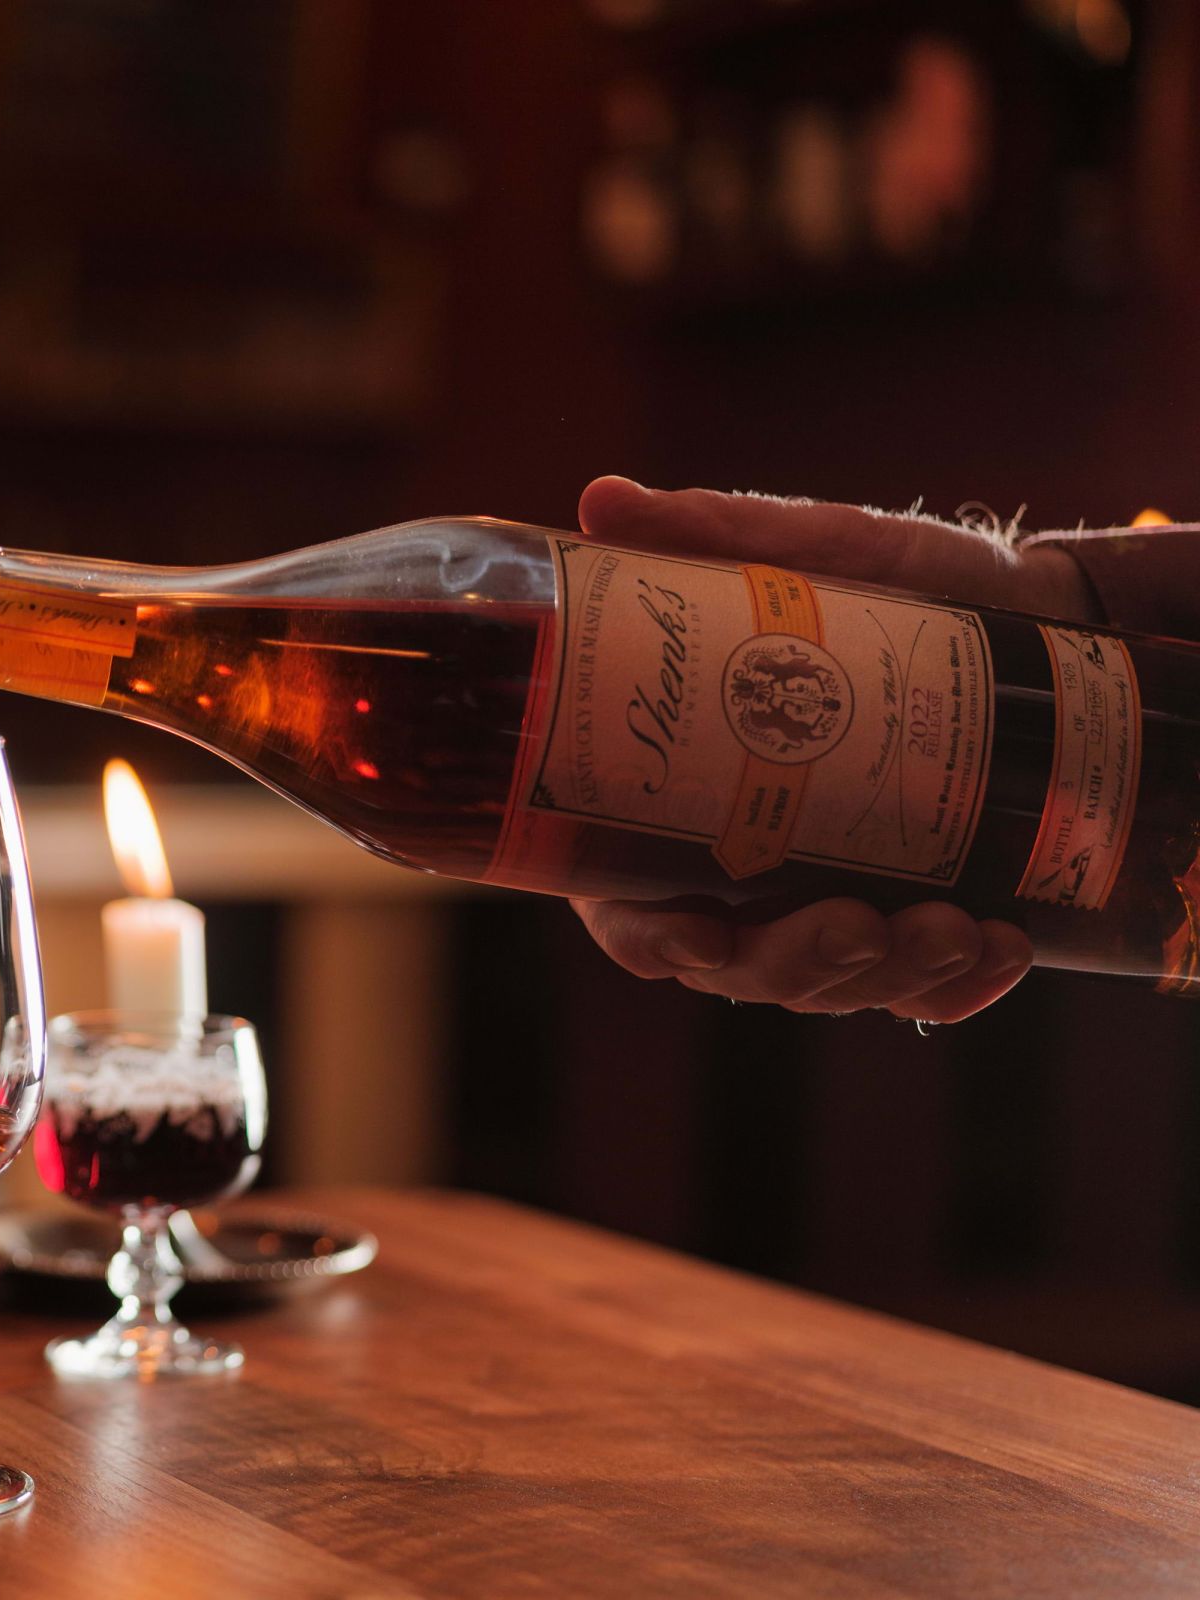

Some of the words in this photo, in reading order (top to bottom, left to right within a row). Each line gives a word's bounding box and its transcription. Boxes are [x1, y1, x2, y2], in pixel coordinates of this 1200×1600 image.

[590, 554, 621, 602] WHISKEY
[582, 605, 603, 650] MASH
[962, 626, 977, 667] KENTUCKY
[576, 653, 595, 702] SOUR
[626, 578, 687, 794] Shenk's
[1062, 662, 1078, 690] 1303
[907, 687, 930, 755] 2022
[926, 691, 943, 758] RELEASE
[1073, 714, 1086, 732] OF
[576, 708, 599, 804] KENTUCKY
[866, 711, 899, 787] Kentucky
[958, 738, 975, 800] DISTILLERY
[1061, 780, 1074, 790] 3
[1050, 815, 1074, 865] BOTTLE
